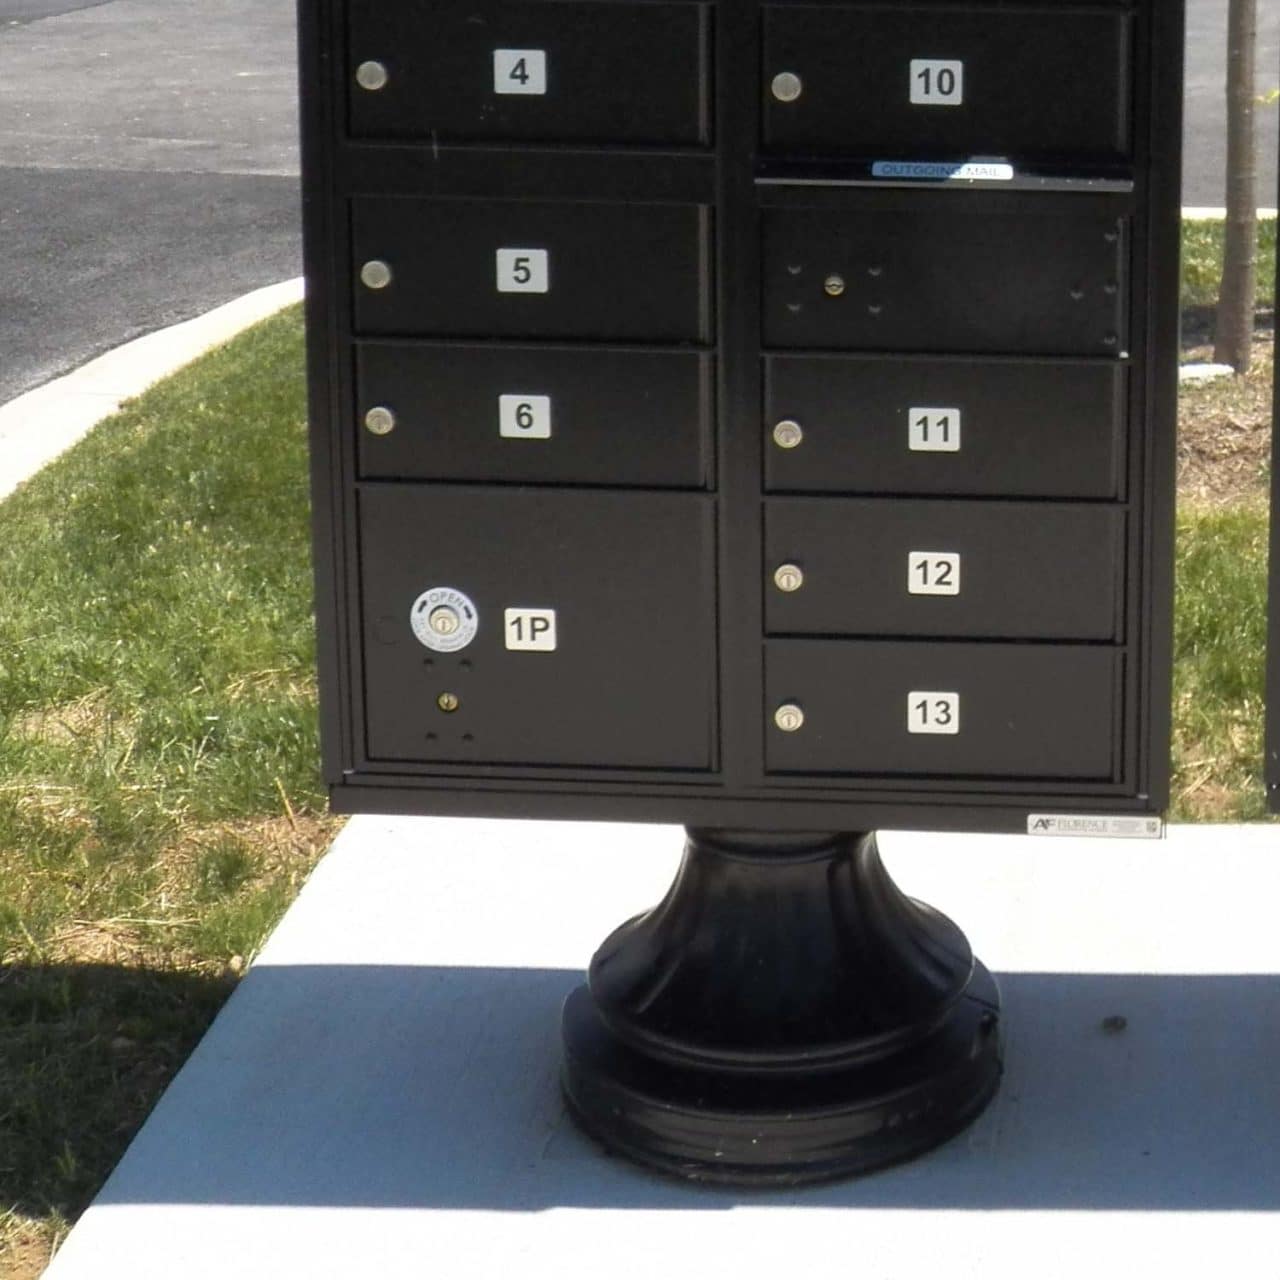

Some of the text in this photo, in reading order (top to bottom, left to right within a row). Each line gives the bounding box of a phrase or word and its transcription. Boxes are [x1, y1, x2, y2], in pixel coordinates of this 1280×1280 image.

[508, 57, 530, 86] 4
[917, 67, 956, 97] 10
[881, 163, 961, 176] OUTGOING
[512, 256, 532, 285] 5
[515, 402, 534, 430] 6
[915, 415, 949, 443] 11
[916, 559, 952, 586] 12
[429, 591, 465, 608] OPEN
[511, 616, 550, 641] 1P
[916, 700, 951, 725] 13
